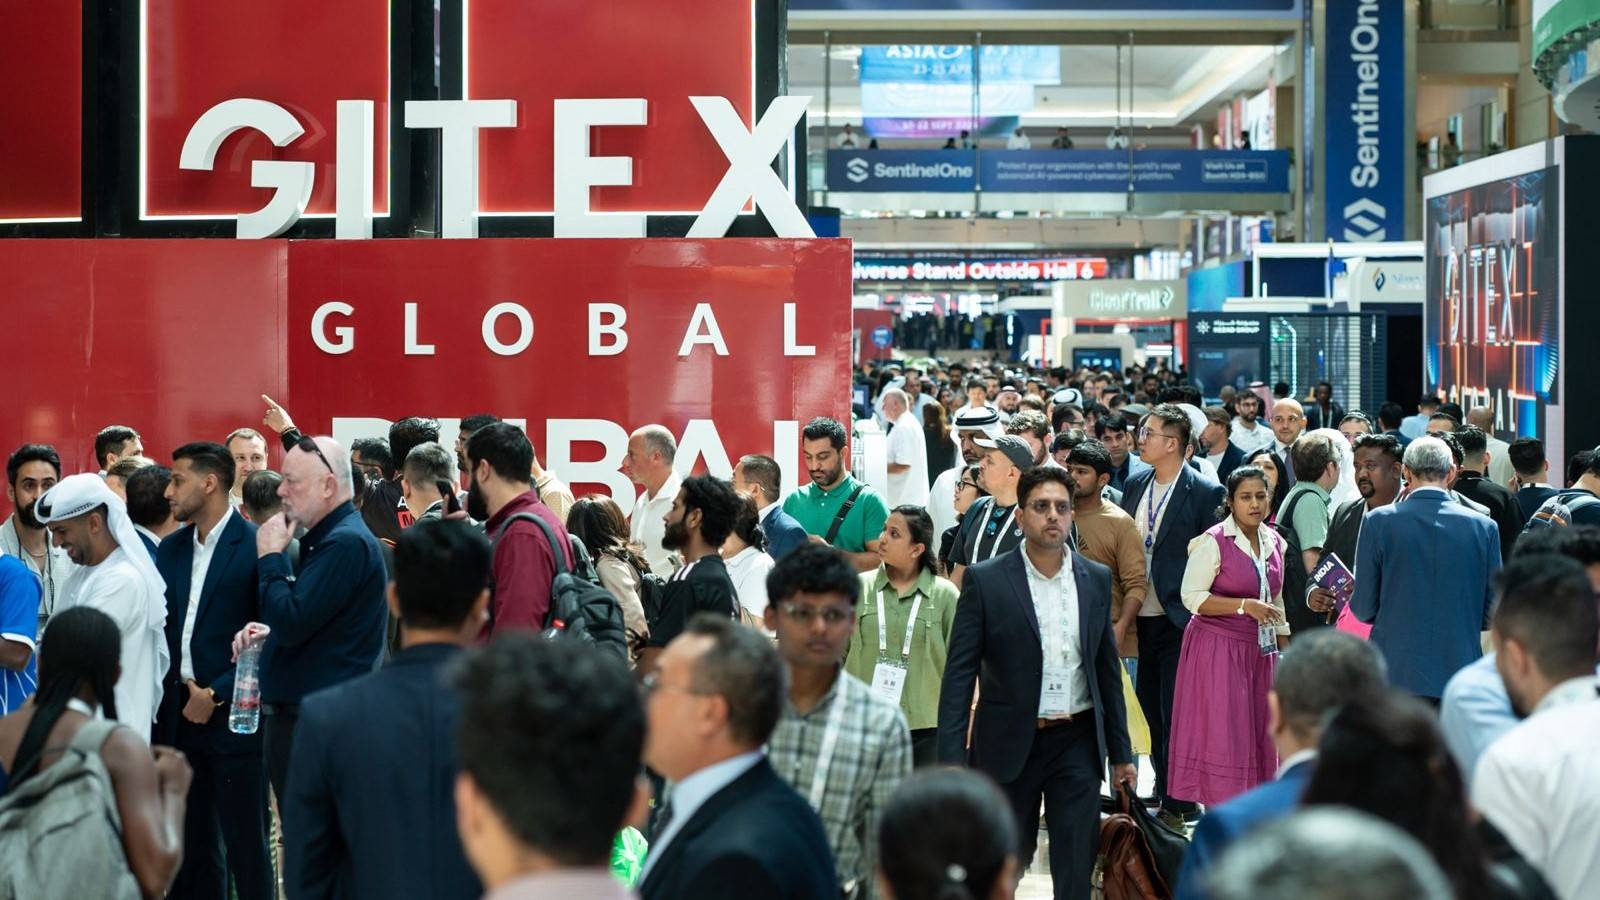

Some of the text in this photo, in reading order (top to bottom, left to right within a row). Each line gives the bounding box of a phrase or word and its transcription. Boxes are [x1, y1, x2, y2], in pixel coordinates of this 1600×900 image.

[1350, 0, 1379, 188] SentinelOn
[179, 96, 818, 239] GITEX
[874, 162, 973, 178] SentinelOne
[853, 261, 1093, 279] iverse Stand Outside Hall 6
[1445, 238, 1517, 345] GITEX
[311, 301, 817, 356] GLOBAL
[332, 416, 799, 518] BAI
[1314, 560, 1335, 583] INDIA
